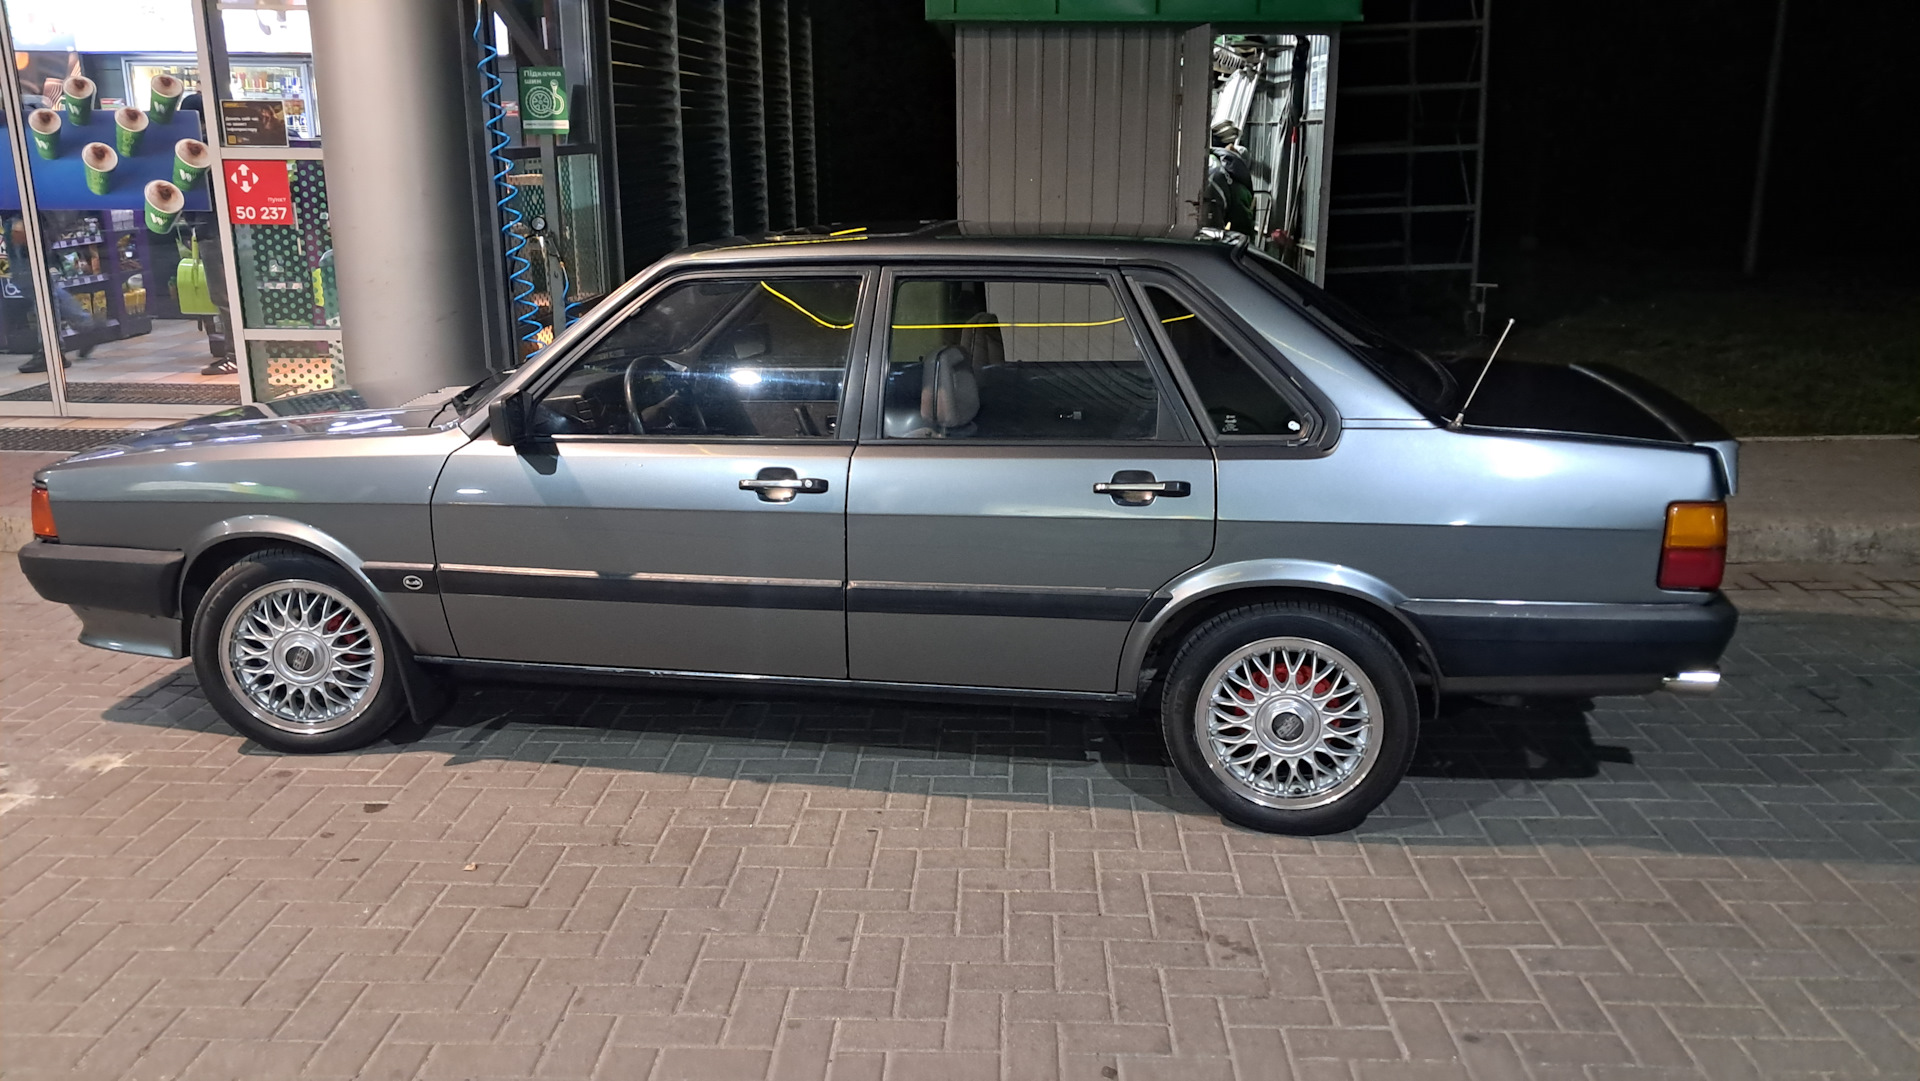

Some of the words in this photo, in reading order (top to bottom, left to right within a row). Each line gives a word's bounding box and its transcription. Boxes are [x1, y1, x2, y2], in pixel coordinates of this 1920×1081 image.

[523, 70, 562, 78] Підкачка
[236, 206, 256, 220] 50
[260, 206, 287, 220] 237
